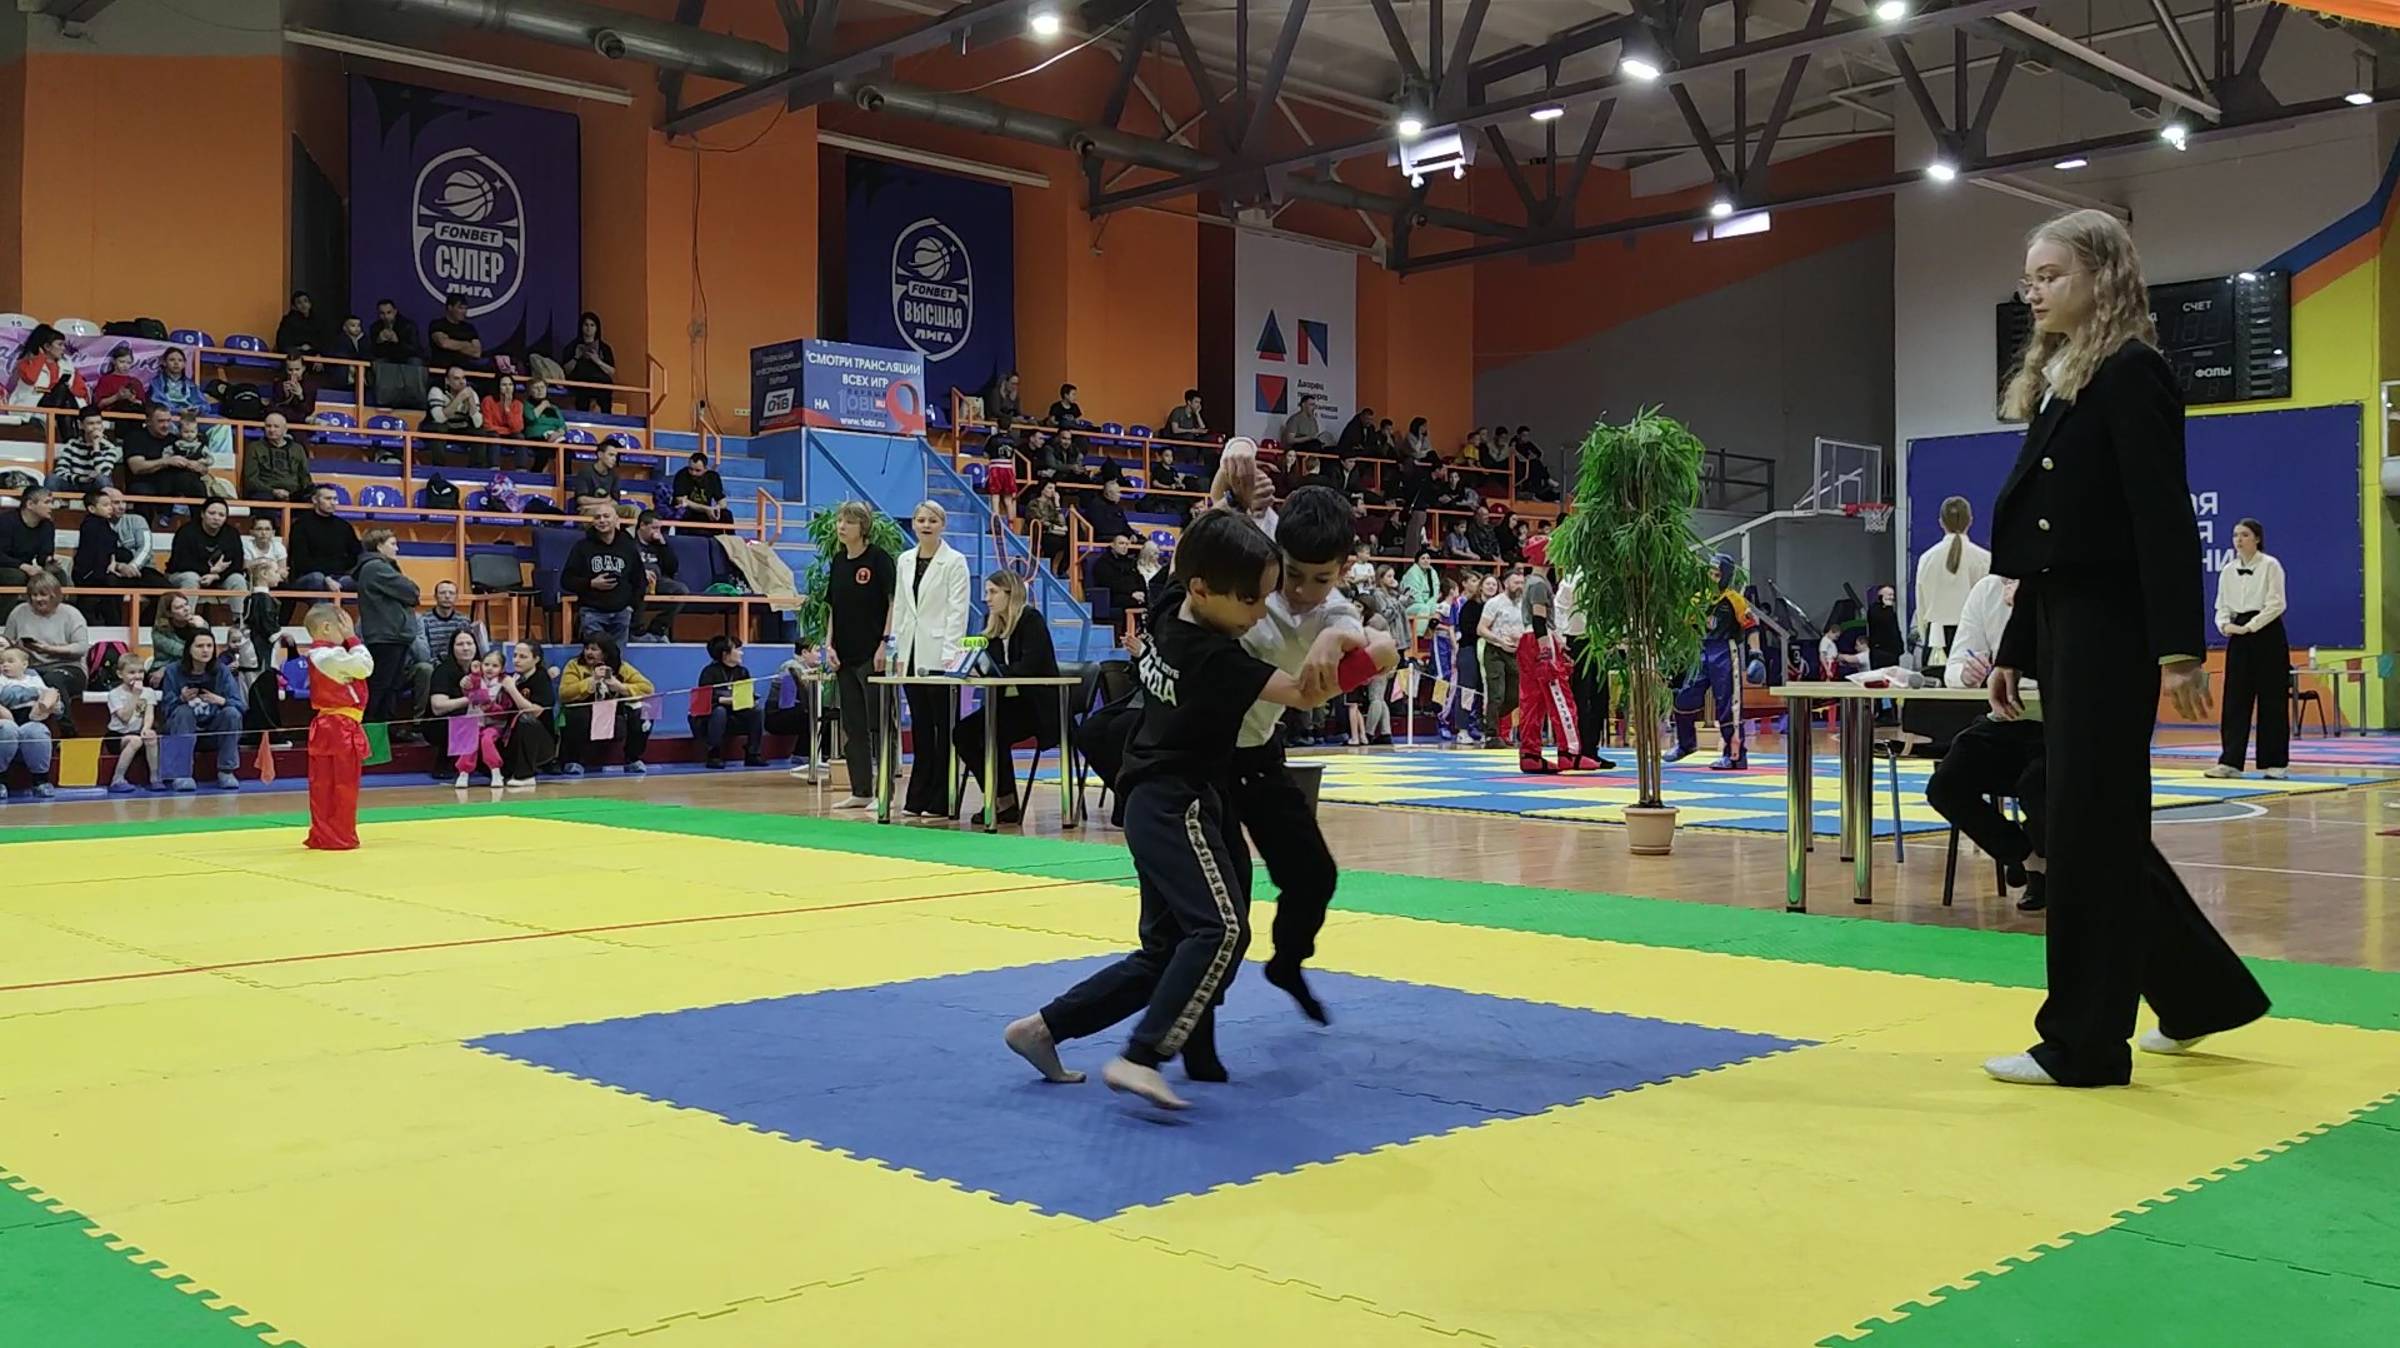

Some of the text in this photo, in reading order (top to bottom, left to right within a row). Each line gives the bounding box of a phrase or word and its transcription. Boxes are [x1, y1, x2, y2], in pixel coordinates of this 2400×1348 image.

[440, 225, 498, 243] FONBET
[435, 244, 505, 284] СУПЕР
[446, 282, 493, 298] ЛИГА
[911, 283, 954, 299] FONBET
[2182, 300, 2213, 312] СЧЕТ
[903, 300, 963, 329] ВЫСШАЯ
[914, 328, 953, 344] ЛИГА
[808, 352, 853, 368] СМОТРИ
[854, 357, 921, 376] ТРАНСЛЯЦИИ
[2194, 366, 2232, 378] ФОЛЫ
[842, 373, 889, 388] ВСЕХ ИГР
[814, 398, 830, 410] НА
[591, 555, 625, 573] GAP
